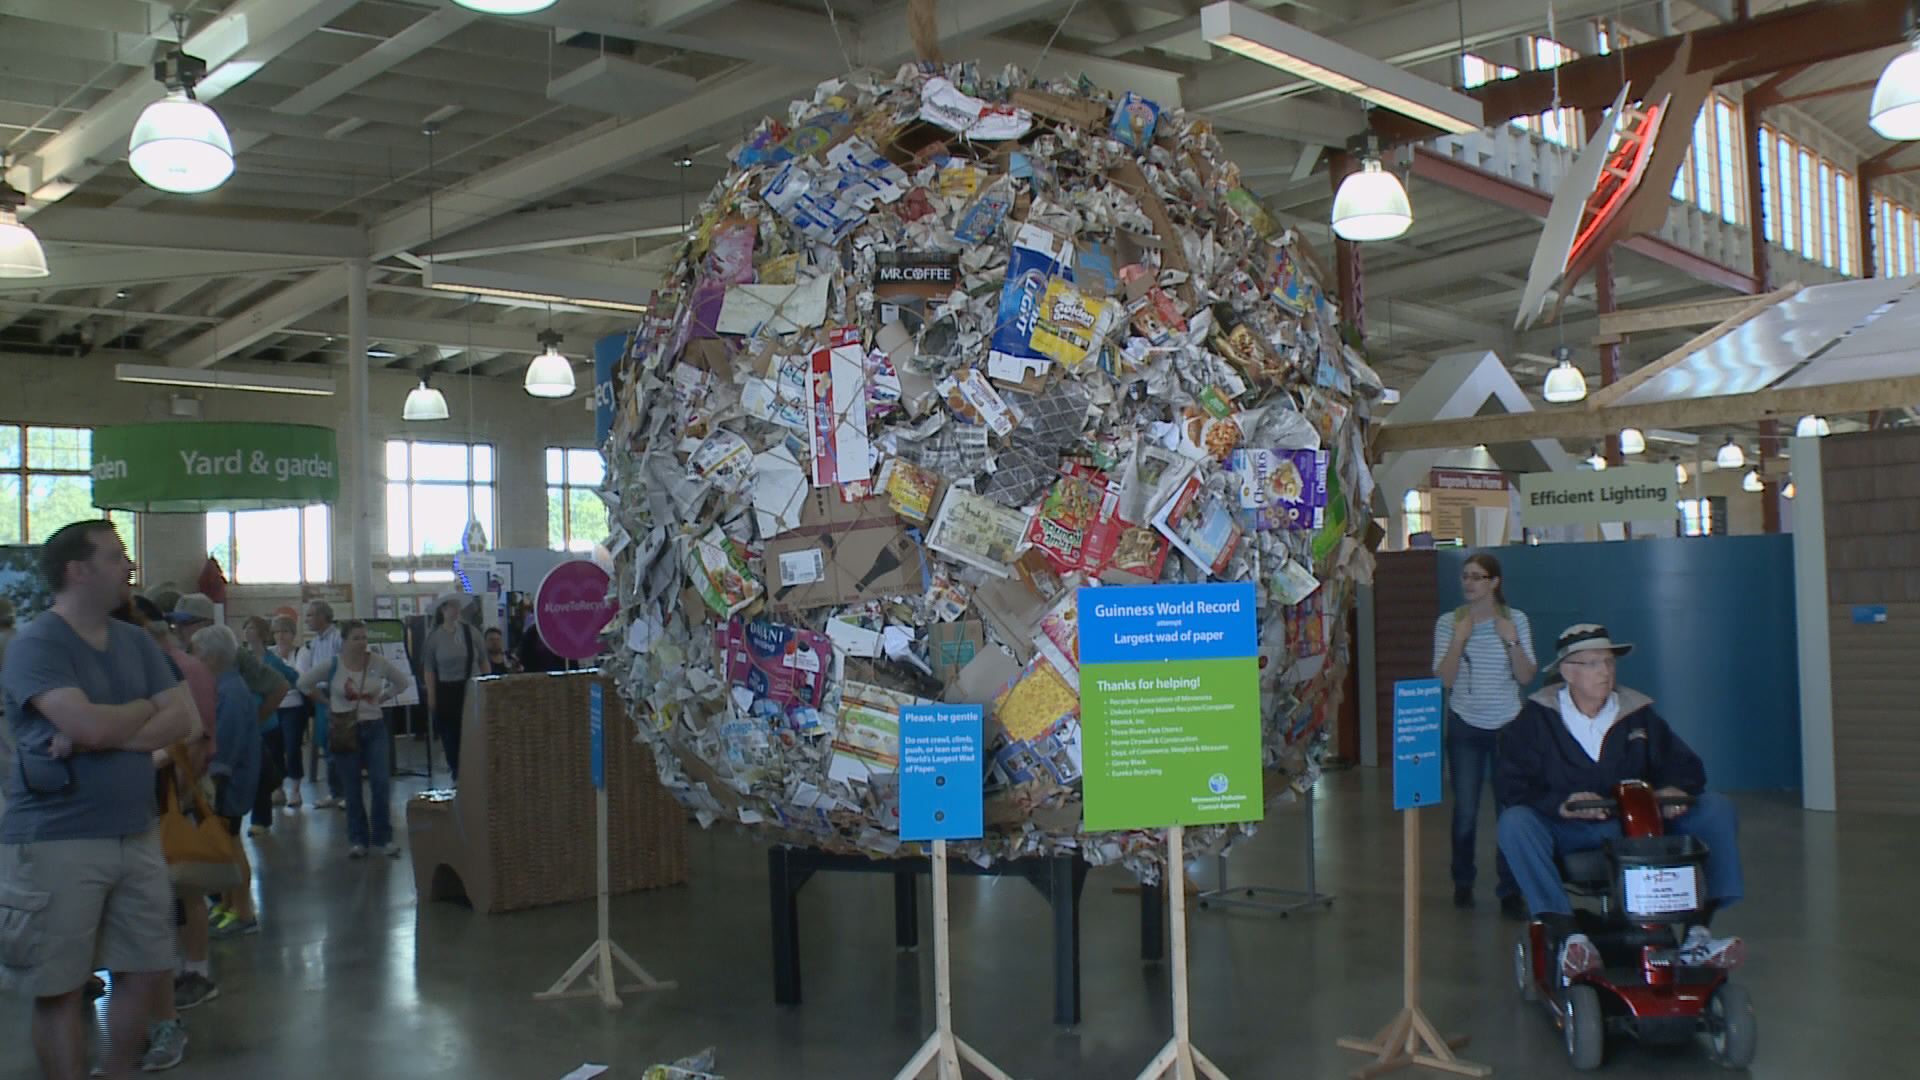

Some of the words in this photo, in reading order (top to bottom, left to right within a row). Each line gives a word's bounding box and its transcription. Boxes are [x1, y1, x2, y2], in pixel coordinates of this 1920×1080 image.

[1016, 275, 1038, 337] LIGHT
[1053, 300, 1096, 329] Golden
[180, 449, 242, 475] Yard
[249, 449, 269, 475] &
[1530, 489, 1594, 506] Efficient
[1601, 485, 1668, 505] Lighting
[1095, 602, 1154, 618] Guinness
[1156, 600, 1194, 616] World
[1197, 599, 1240, 614] Record
[1156, 619, 1182, 627] attempt
[1114, 631, 1154, 646] Largest
[1155, 630, 1179, 643] wad
[1180, 629, 1192, 642] of
[1193, 630, 1224, 644] paper
[1097, 678, 1137, 692] Thanks
[1138, 677, 1154, 690] for
[1156, 676, 1201, 691] helping!
[905, 712, 936, 723] Please,
[937, 712, 948, 721] be
[950, 711, 978, 723] gentle
[905, 736, 916, 745] Do
[916, 736, 929, 744] not
[934, 745, 950, 753] lean
[961, 745, 974, 753] the
[905, 755, 931, 764] World's
[932, 755, 958, 765] Largest
[959, 754, 975, 763] Wad
[905, 765, 913, 773] of
